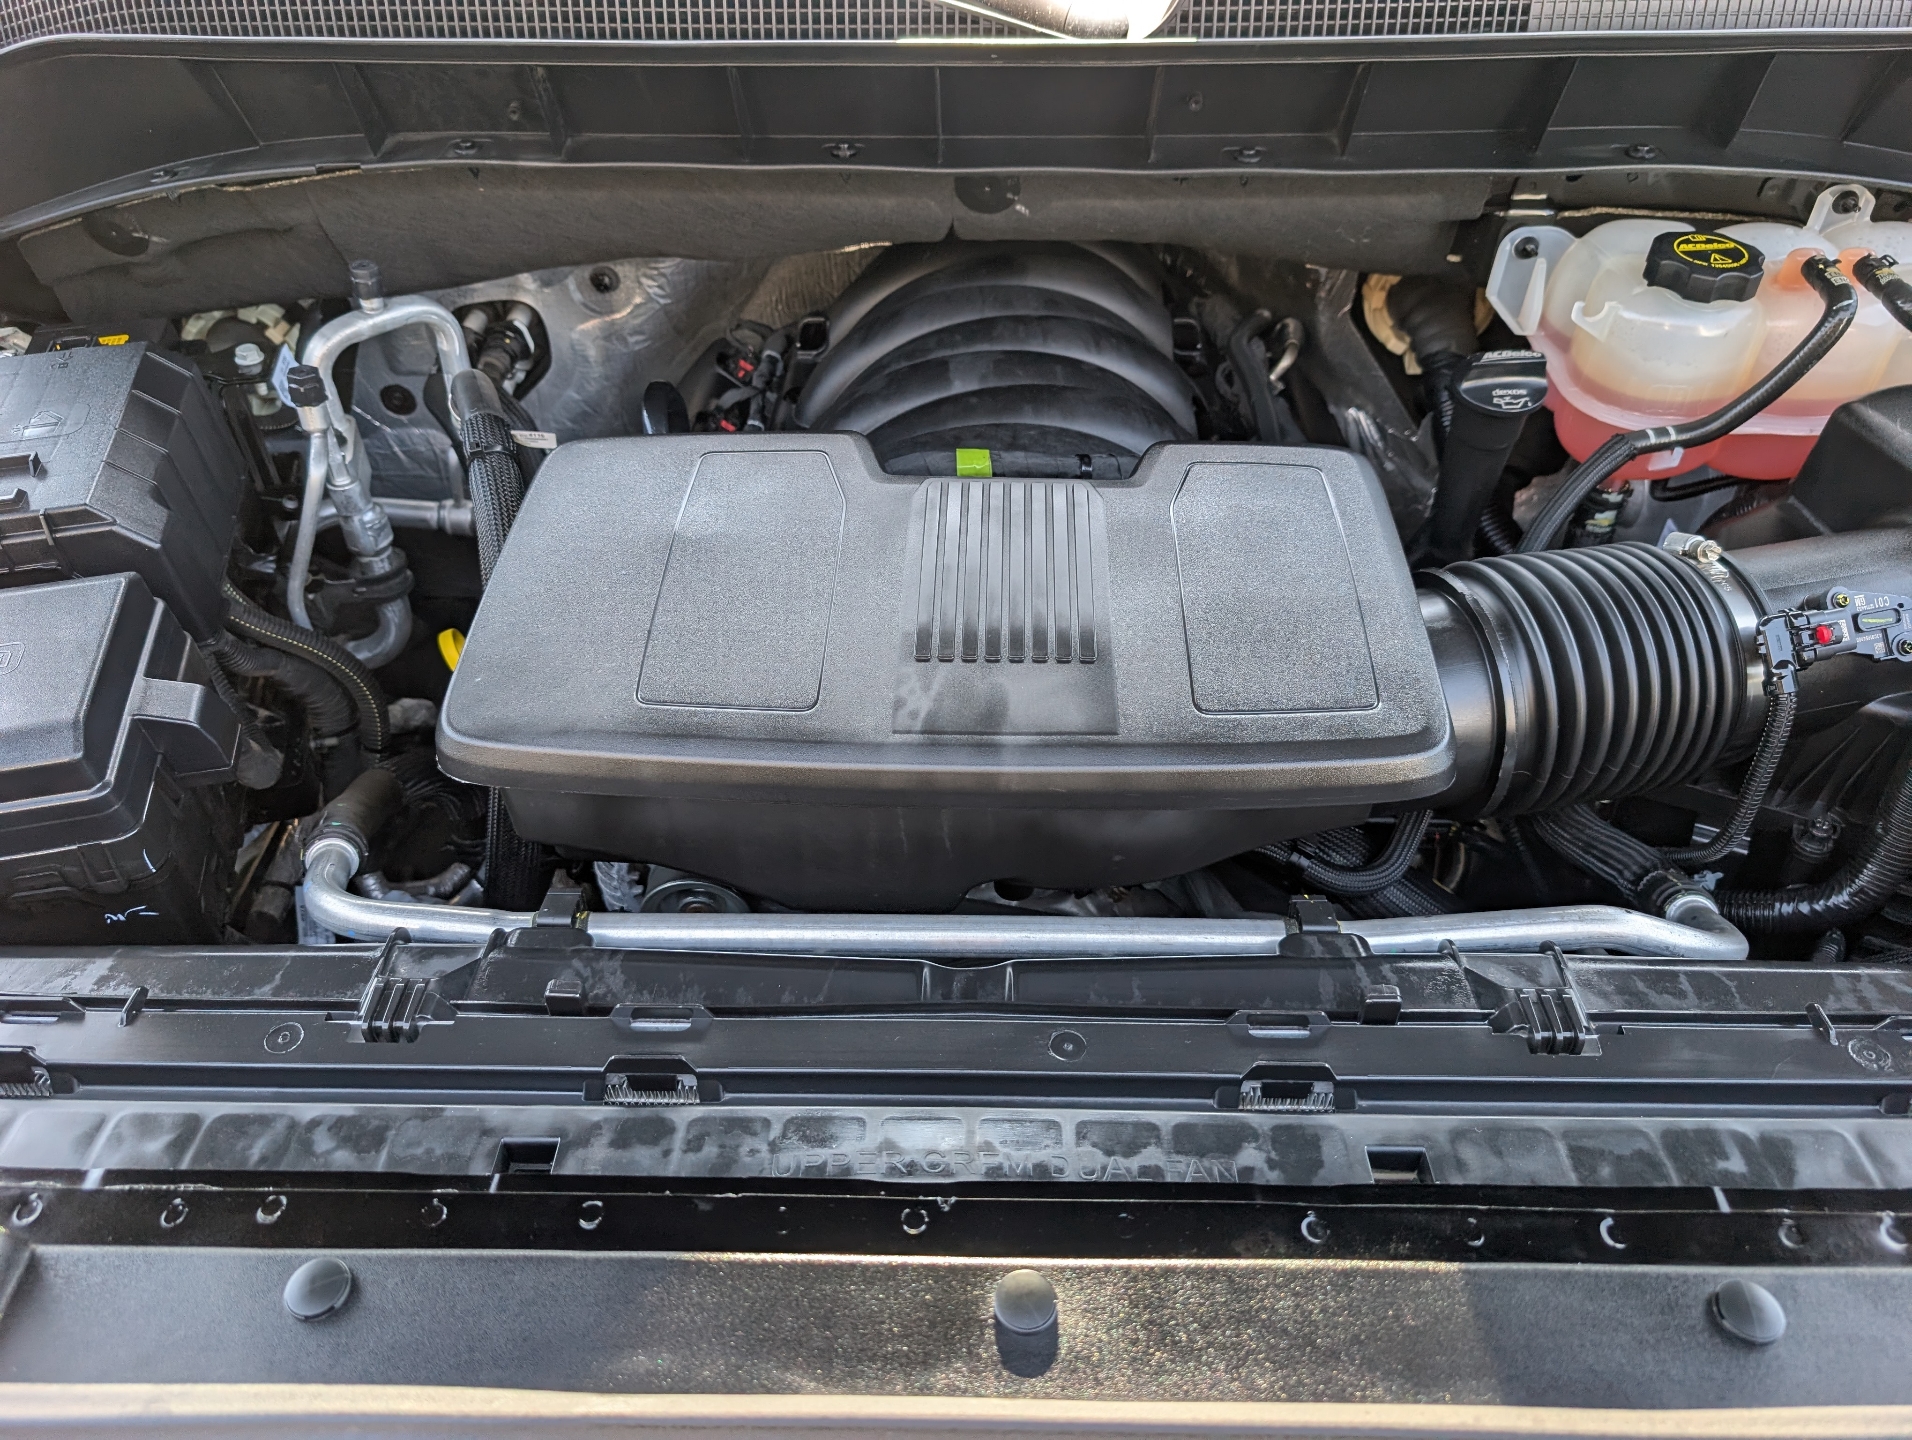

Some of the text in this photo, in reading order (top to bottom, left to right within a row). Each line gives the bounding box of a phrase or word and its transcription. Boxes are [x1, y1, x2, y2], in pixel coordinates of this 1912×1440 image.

[1678, 242, 1736, 251] ACDelco
[1482, 349, 1542, 360] ACDelco
[1491, 388, 1528, 396] dexos
[1854, 596, 1866, 606] GM
[771, 1149, 908, 1178] UPPER
[1049, 1154, 1154, 1182] DUAL
[1164, 1157, 1240, 1183] FAN
